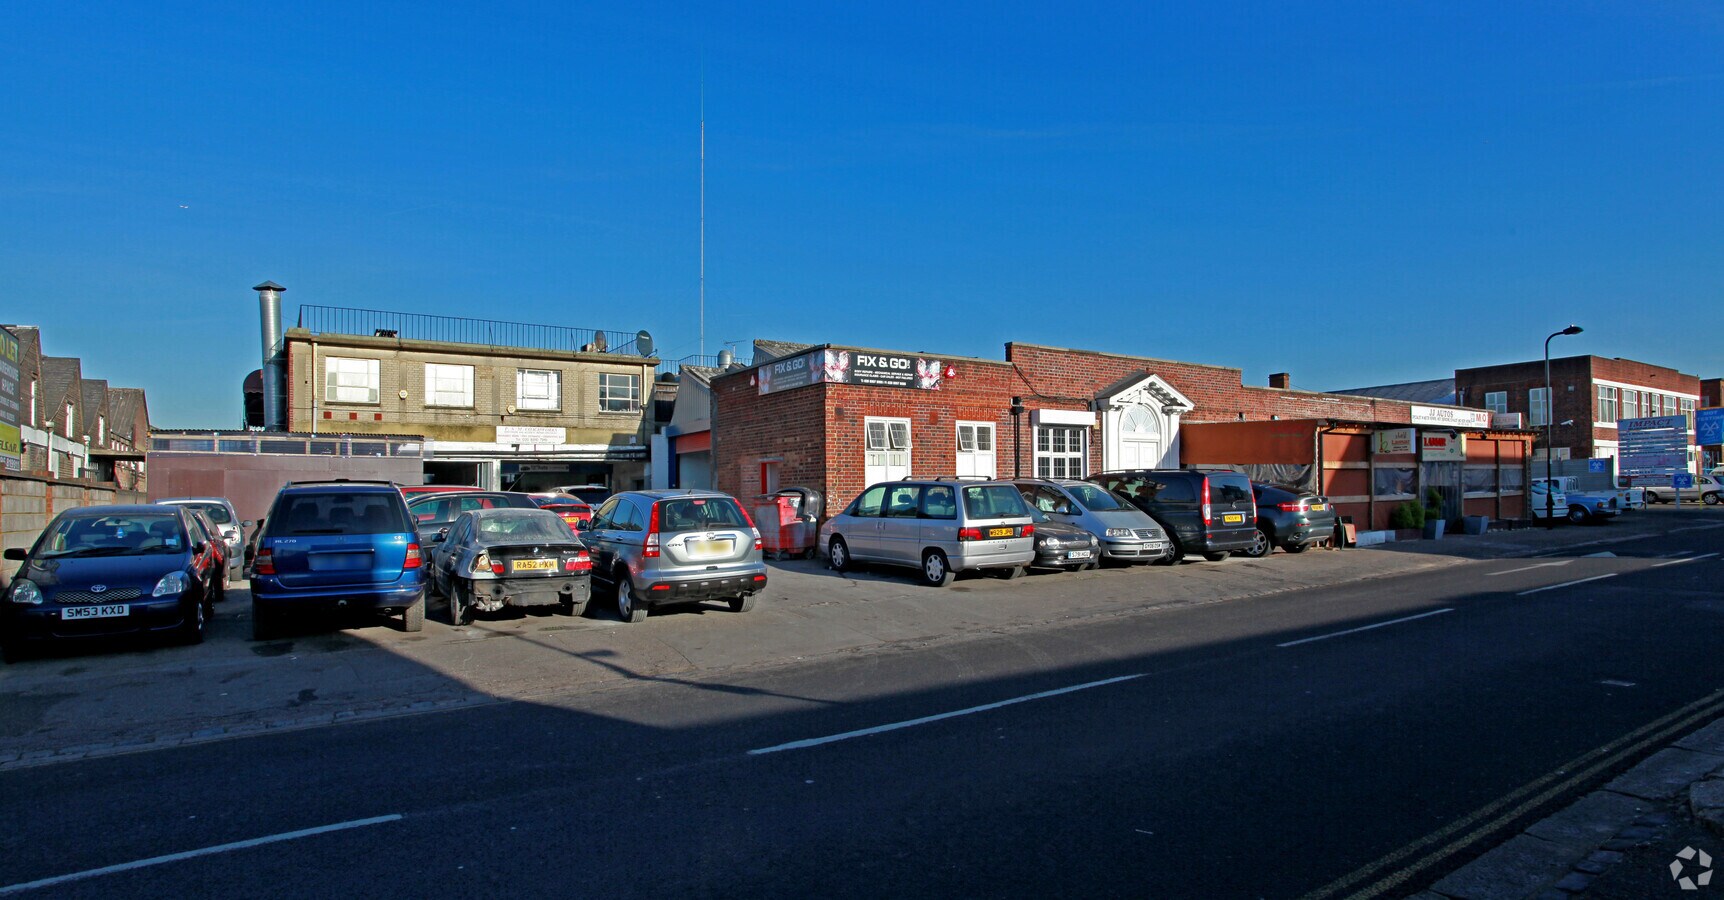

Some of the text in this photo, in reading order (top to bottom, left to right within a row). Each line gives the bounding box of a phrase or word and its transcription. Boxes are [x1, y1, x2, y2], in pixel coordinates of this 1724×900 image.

[6, 337, 18, 364] LET
[857, 355, 877, 367] FIX
[879, 357, 888, 368] &
[774, 363, 785, 375] FIX
[786, 362, 792, 372] &
[1437, 409, 1454, 418] AUTOS
[1628, 418, 1673, 427] IMPACT
[516, 561, 537, 569] RA52
[67, 606, 124, 617] SM53 KXD
